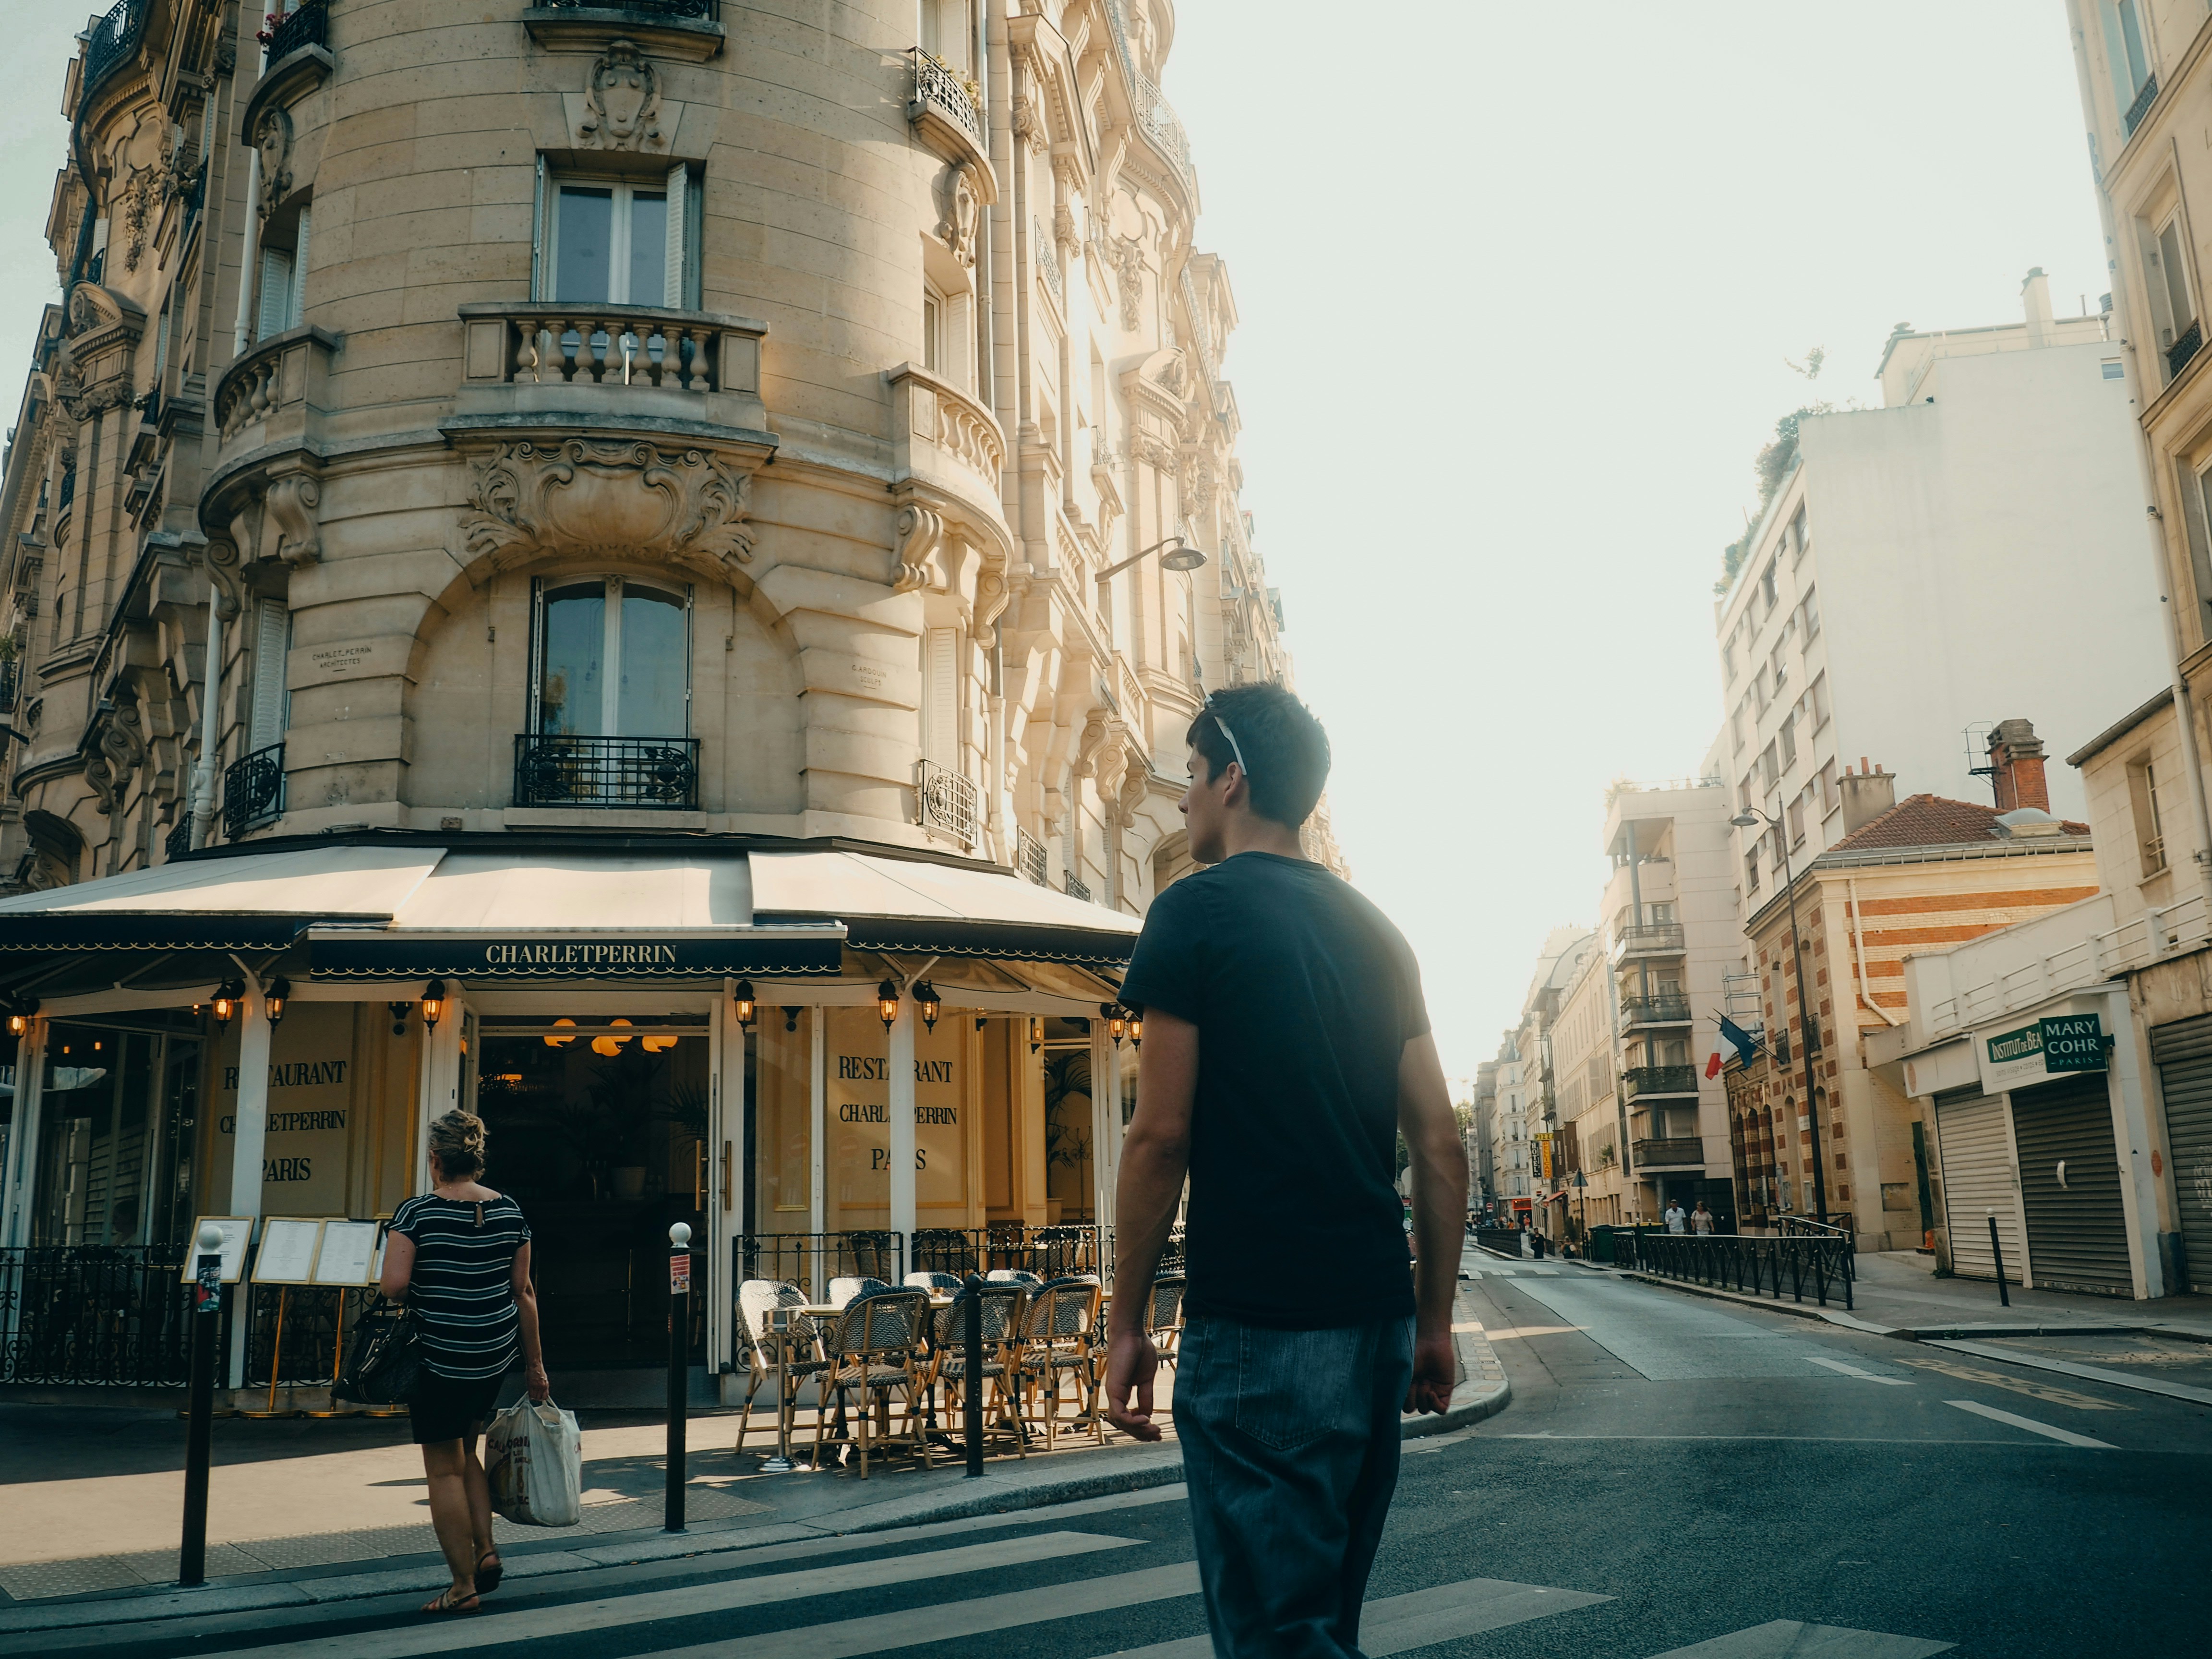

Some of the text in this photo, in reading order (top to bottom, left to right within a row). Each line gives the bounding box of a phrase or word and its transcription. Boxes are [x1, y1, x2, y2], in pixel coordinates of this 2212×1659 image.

[486, 945, 677, 963] CHARLETPERRIN
[2045, 1021, 2095, 1036] MARY
[1991, 1038, 2021, 1061] INSTITUT
[2048, 1038, 2099, 1055] COHR
[838, 1056, 953, 1083] RESTRANT
[2059, 1058, 2092, 1066] PARIS
[222, 1060, 347, 1090] RAURANT
[840, 1104, 957, 1125] CHARLERRIN
[1543, 1142, 1551, 1178] PELLICANO
